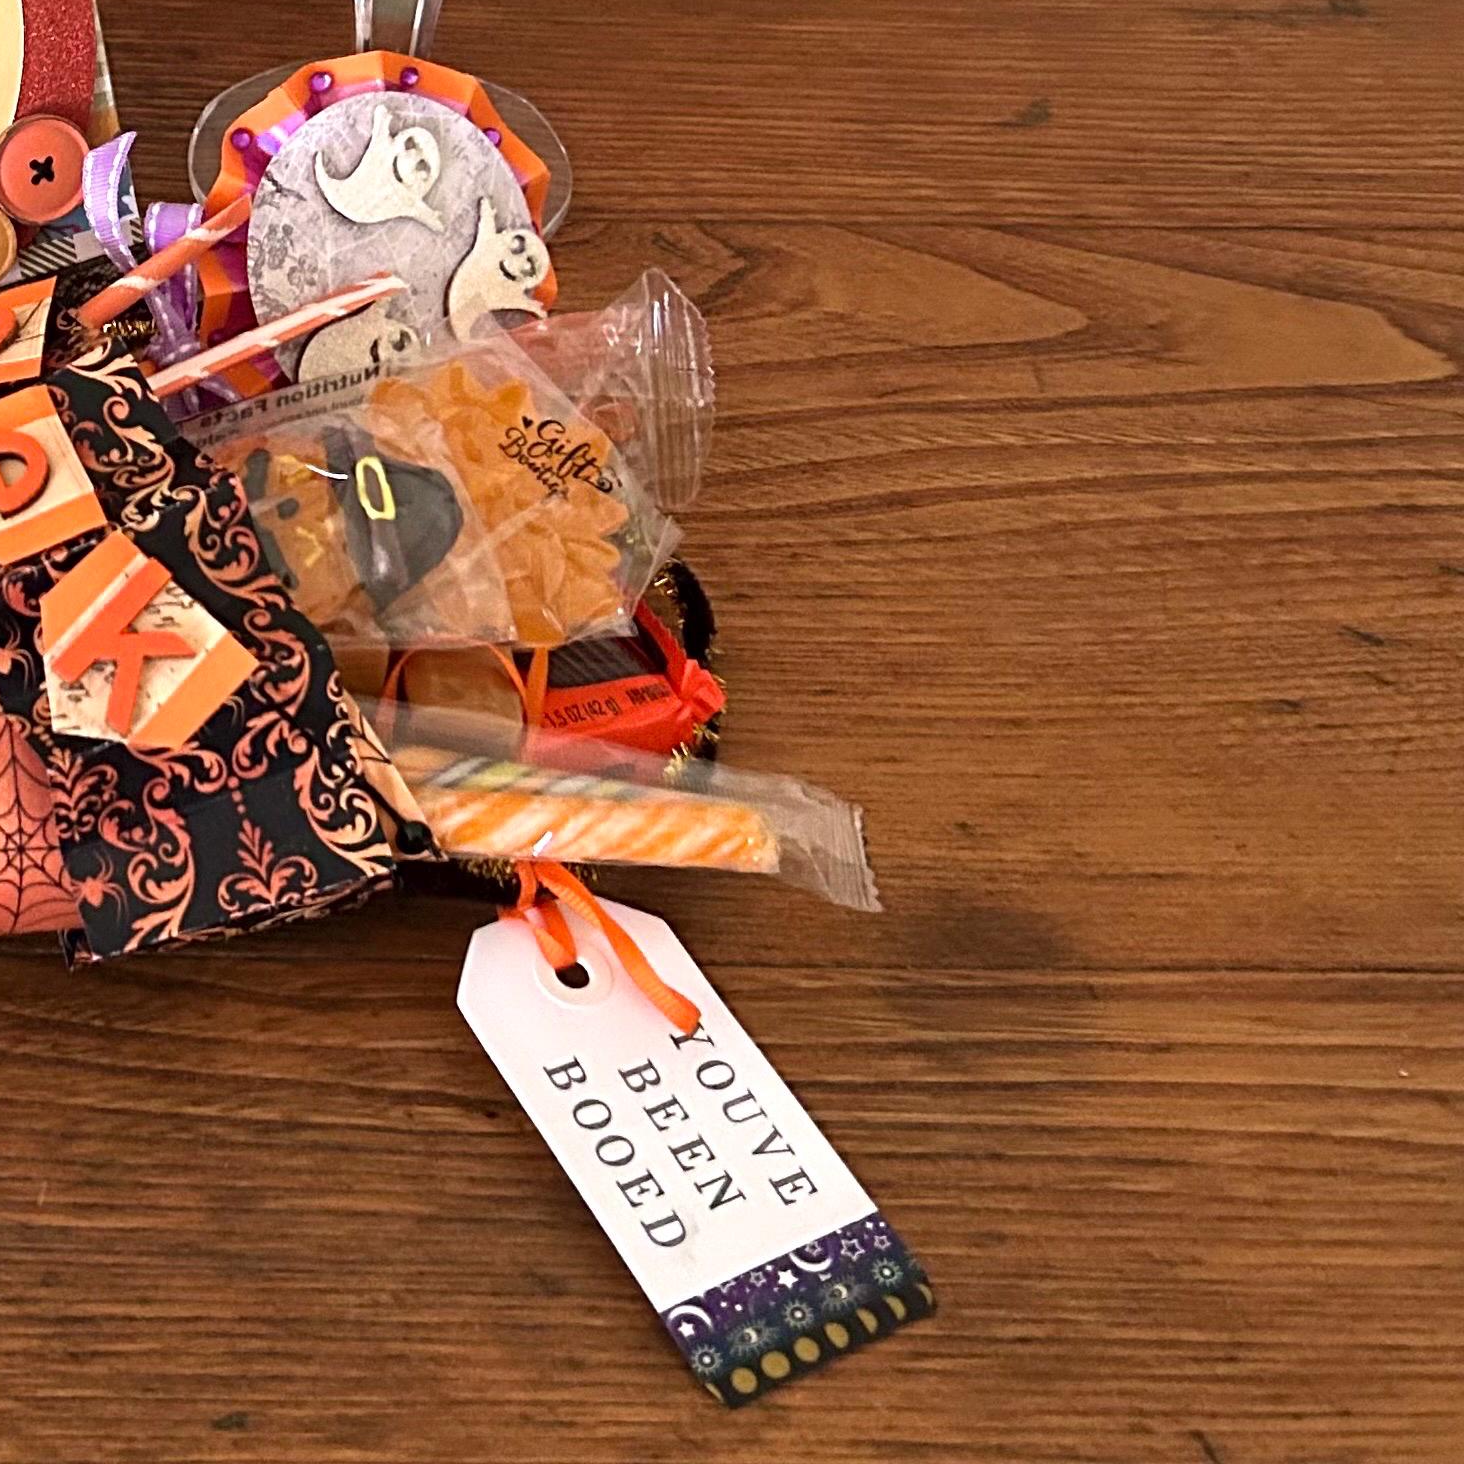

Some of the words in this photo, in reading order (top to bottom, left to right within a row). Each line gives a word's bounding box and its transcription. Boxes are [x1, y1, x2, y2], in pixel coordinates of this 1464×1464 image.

[527, 419, 618, 494] Gift
[543, 1056, 688, 1250] BOOED
[618, 1058, 747, 1213] BEEN
[669, 1022, 819, 1206] YOUVE
